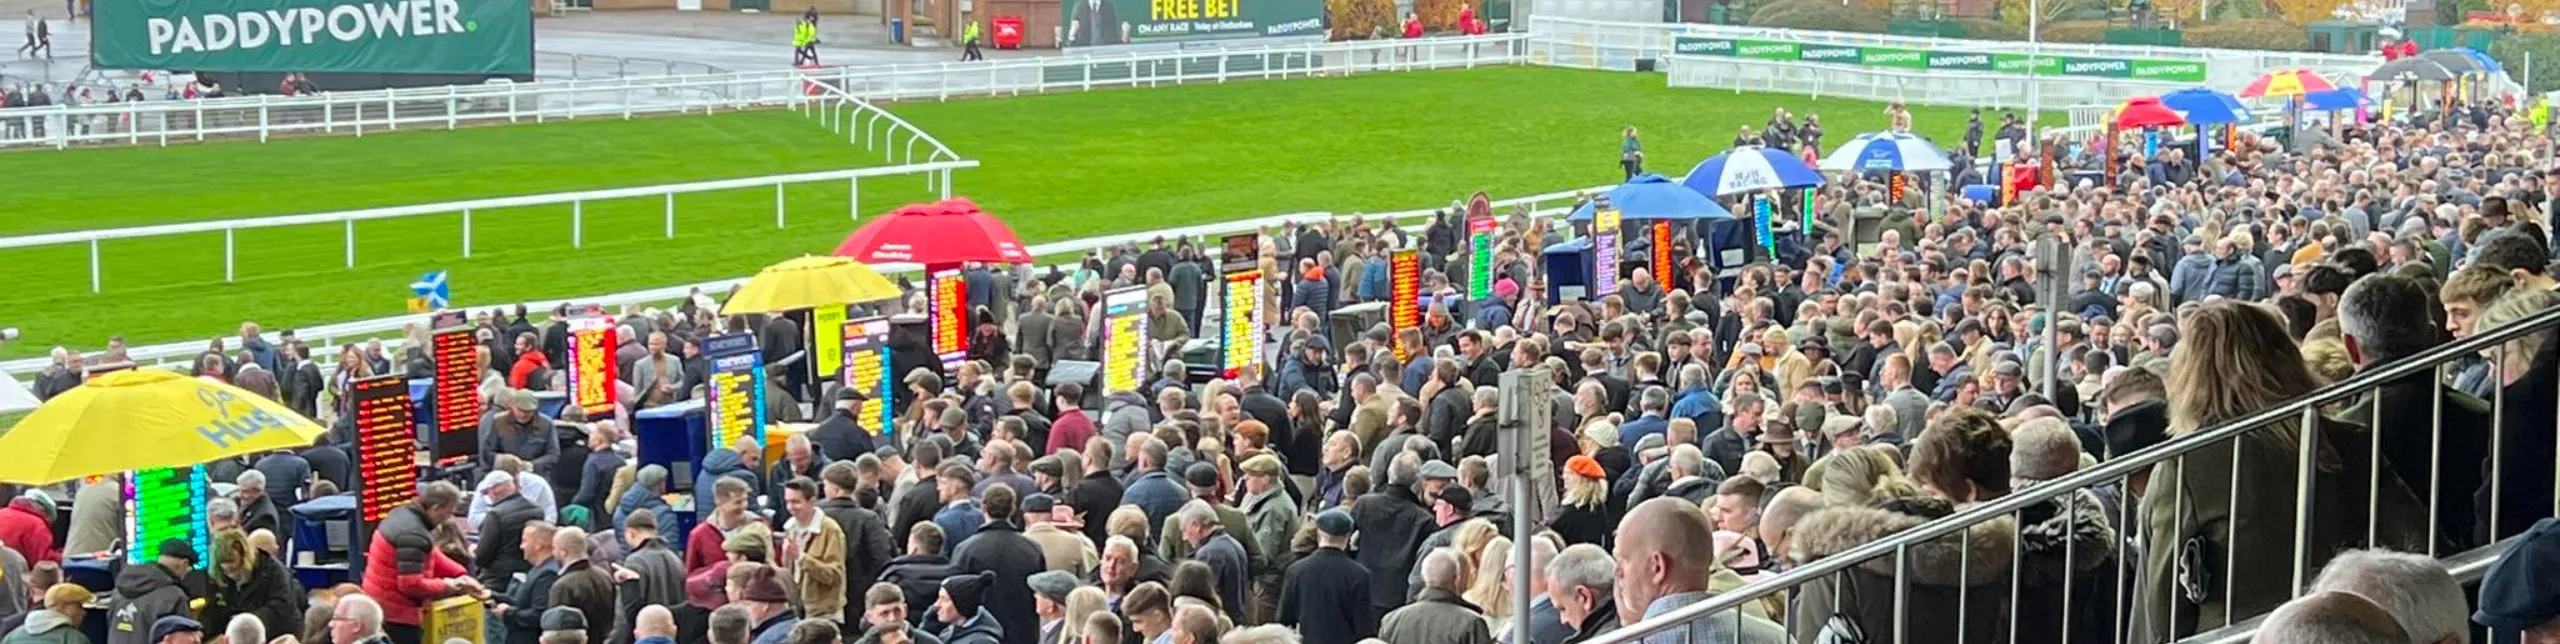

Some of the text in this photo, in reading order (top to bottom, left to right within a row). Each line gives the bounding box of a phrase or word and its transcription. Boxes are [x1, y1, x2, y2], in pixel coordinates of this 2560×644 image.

[1151, 0, 1240, 20] FREE BET
[1138, 24, 1151, 34] ON
[1152, 22, 1169, 33] ANY
[1170, 22, 1190, 32] RACE
[1194, 22, 1211, 32] Today
